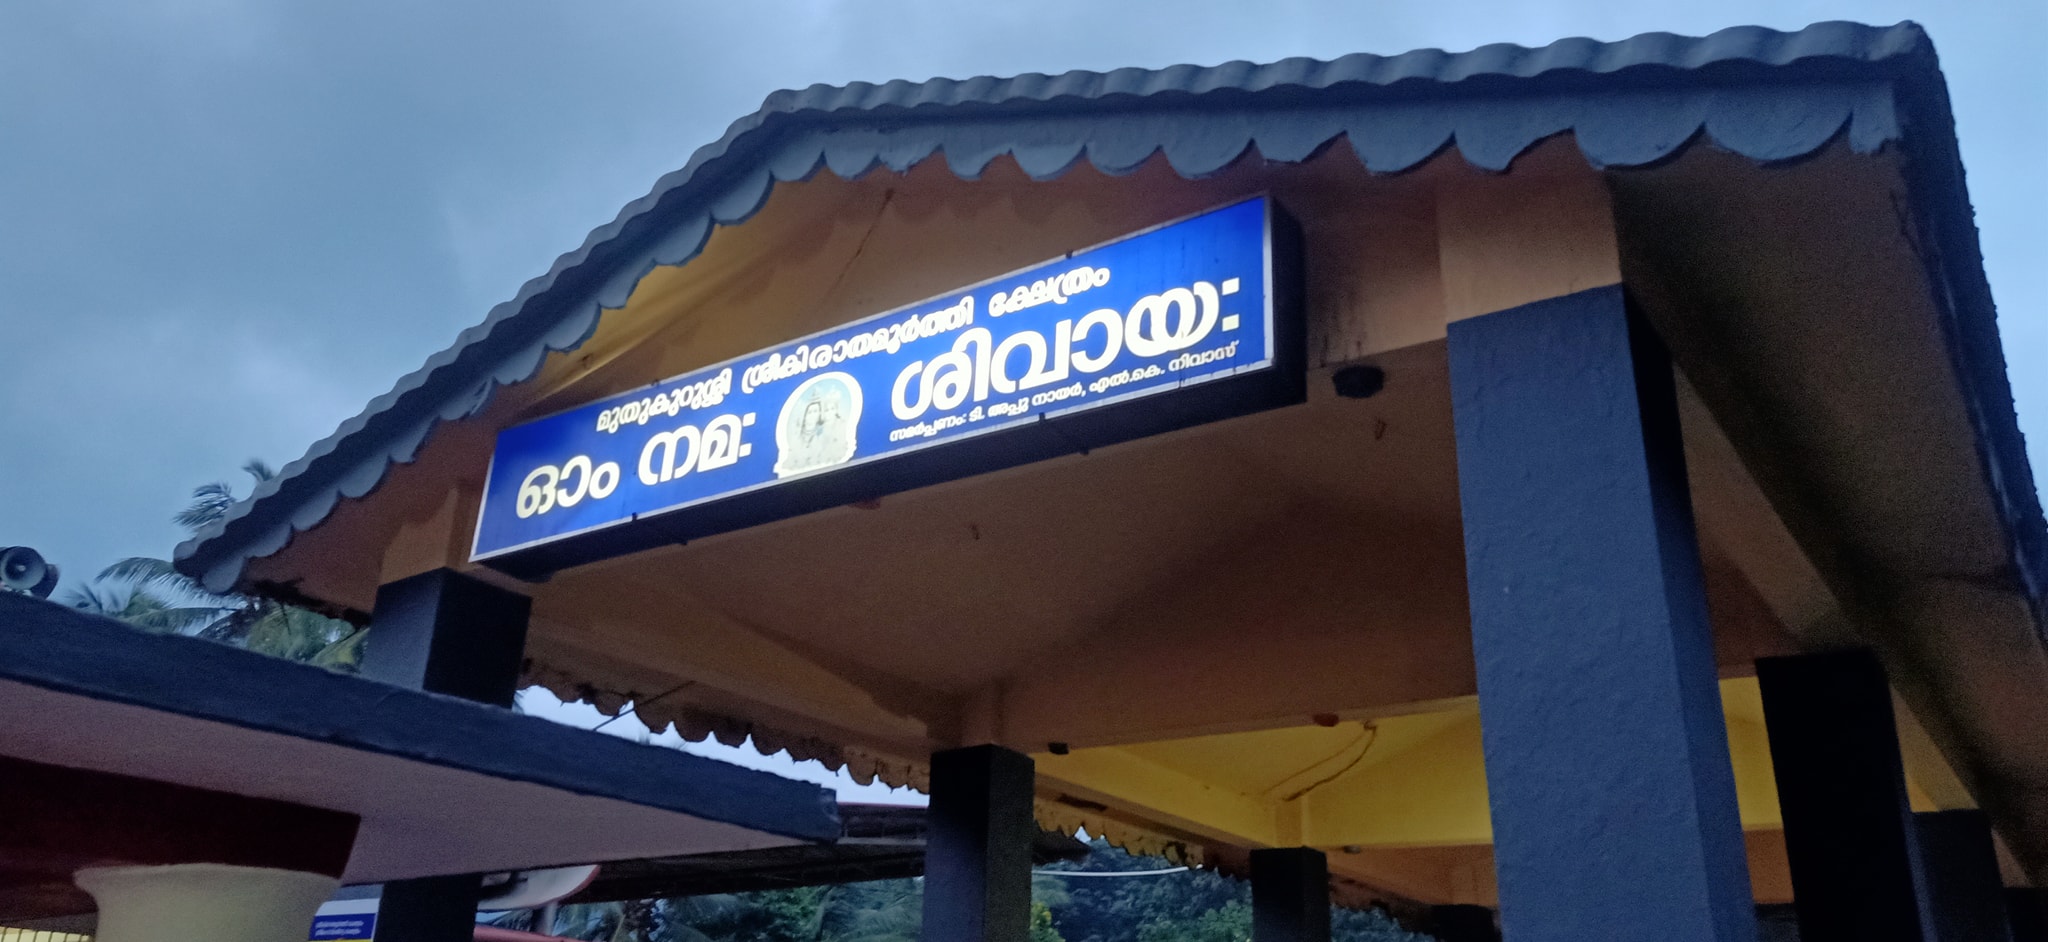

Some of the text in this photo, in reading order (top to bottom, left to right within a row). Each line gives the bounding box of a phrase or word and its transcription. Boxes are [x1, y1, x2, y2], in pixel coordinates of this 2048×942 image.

[988, 266, 1111, 318] ക്ഷേത്രം
[1168, 339, 1239, 373] നിവാസ്
[516, 455, 620, 519] ഓം
